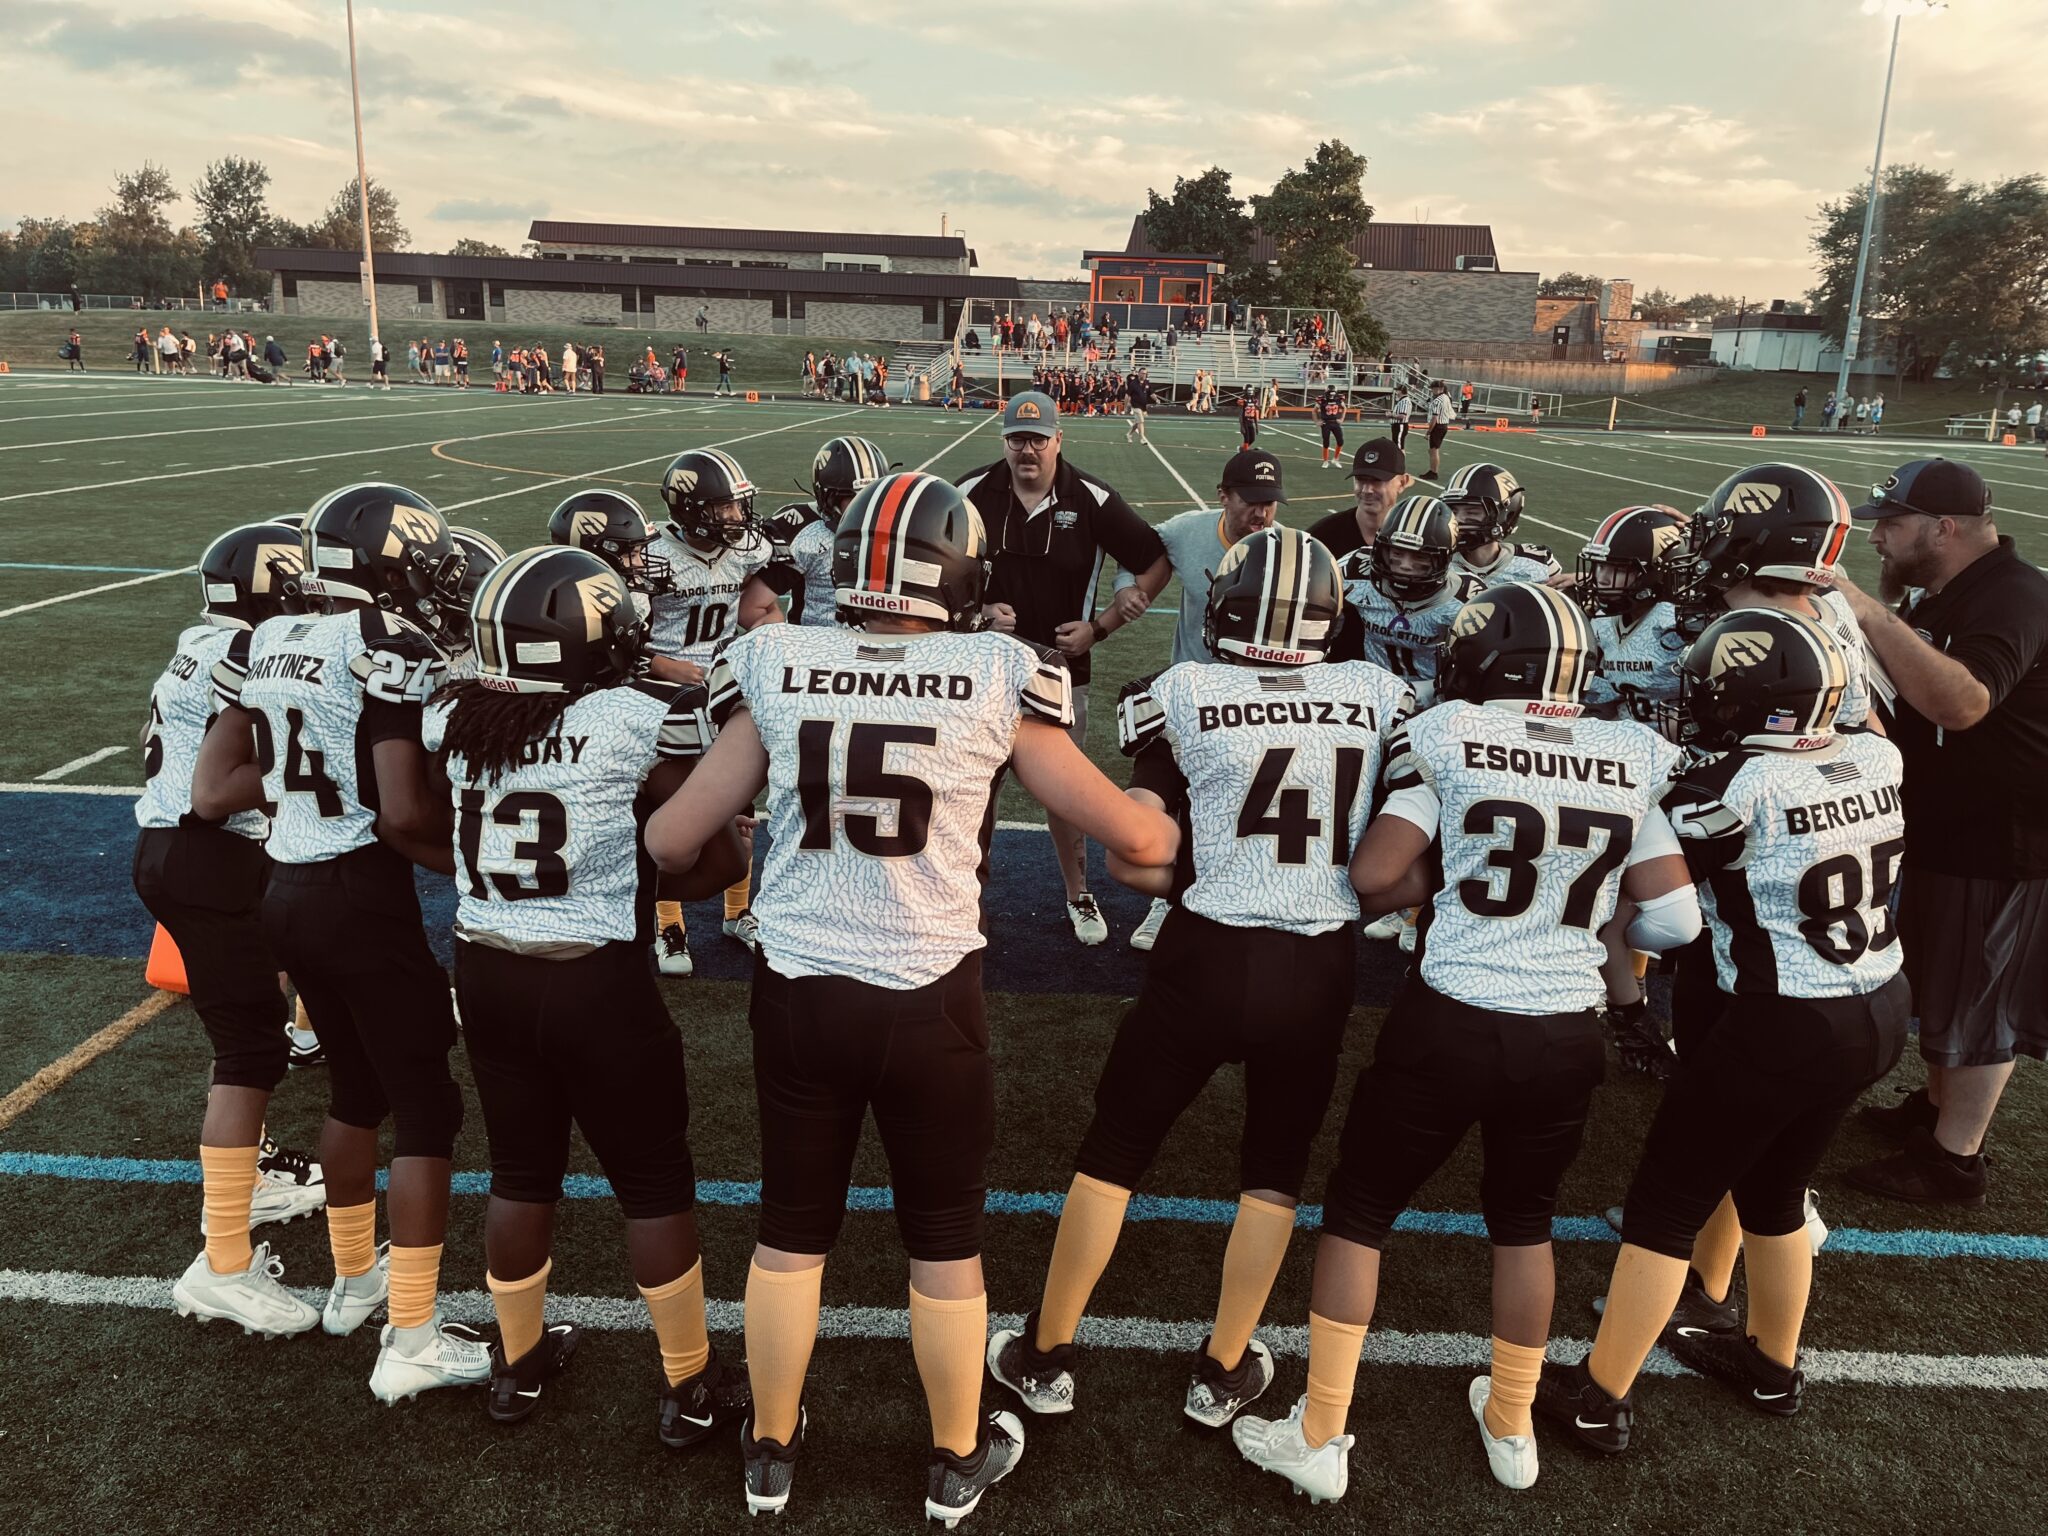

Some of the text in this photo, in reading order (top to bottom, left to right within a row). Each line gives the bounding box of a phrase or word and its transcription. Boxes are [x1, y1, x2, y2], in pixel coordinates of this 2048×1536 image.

[674, 583, 741, 599] CAROL STREA
[1805, 570, 1834, 586] Ridde
[850, 593, 911, 612] Riddell
[683, 603, 728, 647] 10
[1245, 645, 1306, 663] Riddell
[1617, 661, 1654, 672] STREAM
[365, 649, 434, 705] 24
[782, 666, 973, 701] LEONARD
[1199, 701, 1378, 732] BOCCUZZI
[1525, 702, 1580, 718] Riddell
[1462, 741, 1638, 790] ESQUIVEL
[797, 719, 938, 857] 15
[1235, 746, 1366, 867] 41
[1784, 783, 1902, 836] BERGLUN
[457, 788, 570, 901] 13
[1459, 798, 1635, 930] 37
[1797, 838, 1905, 965] 85
